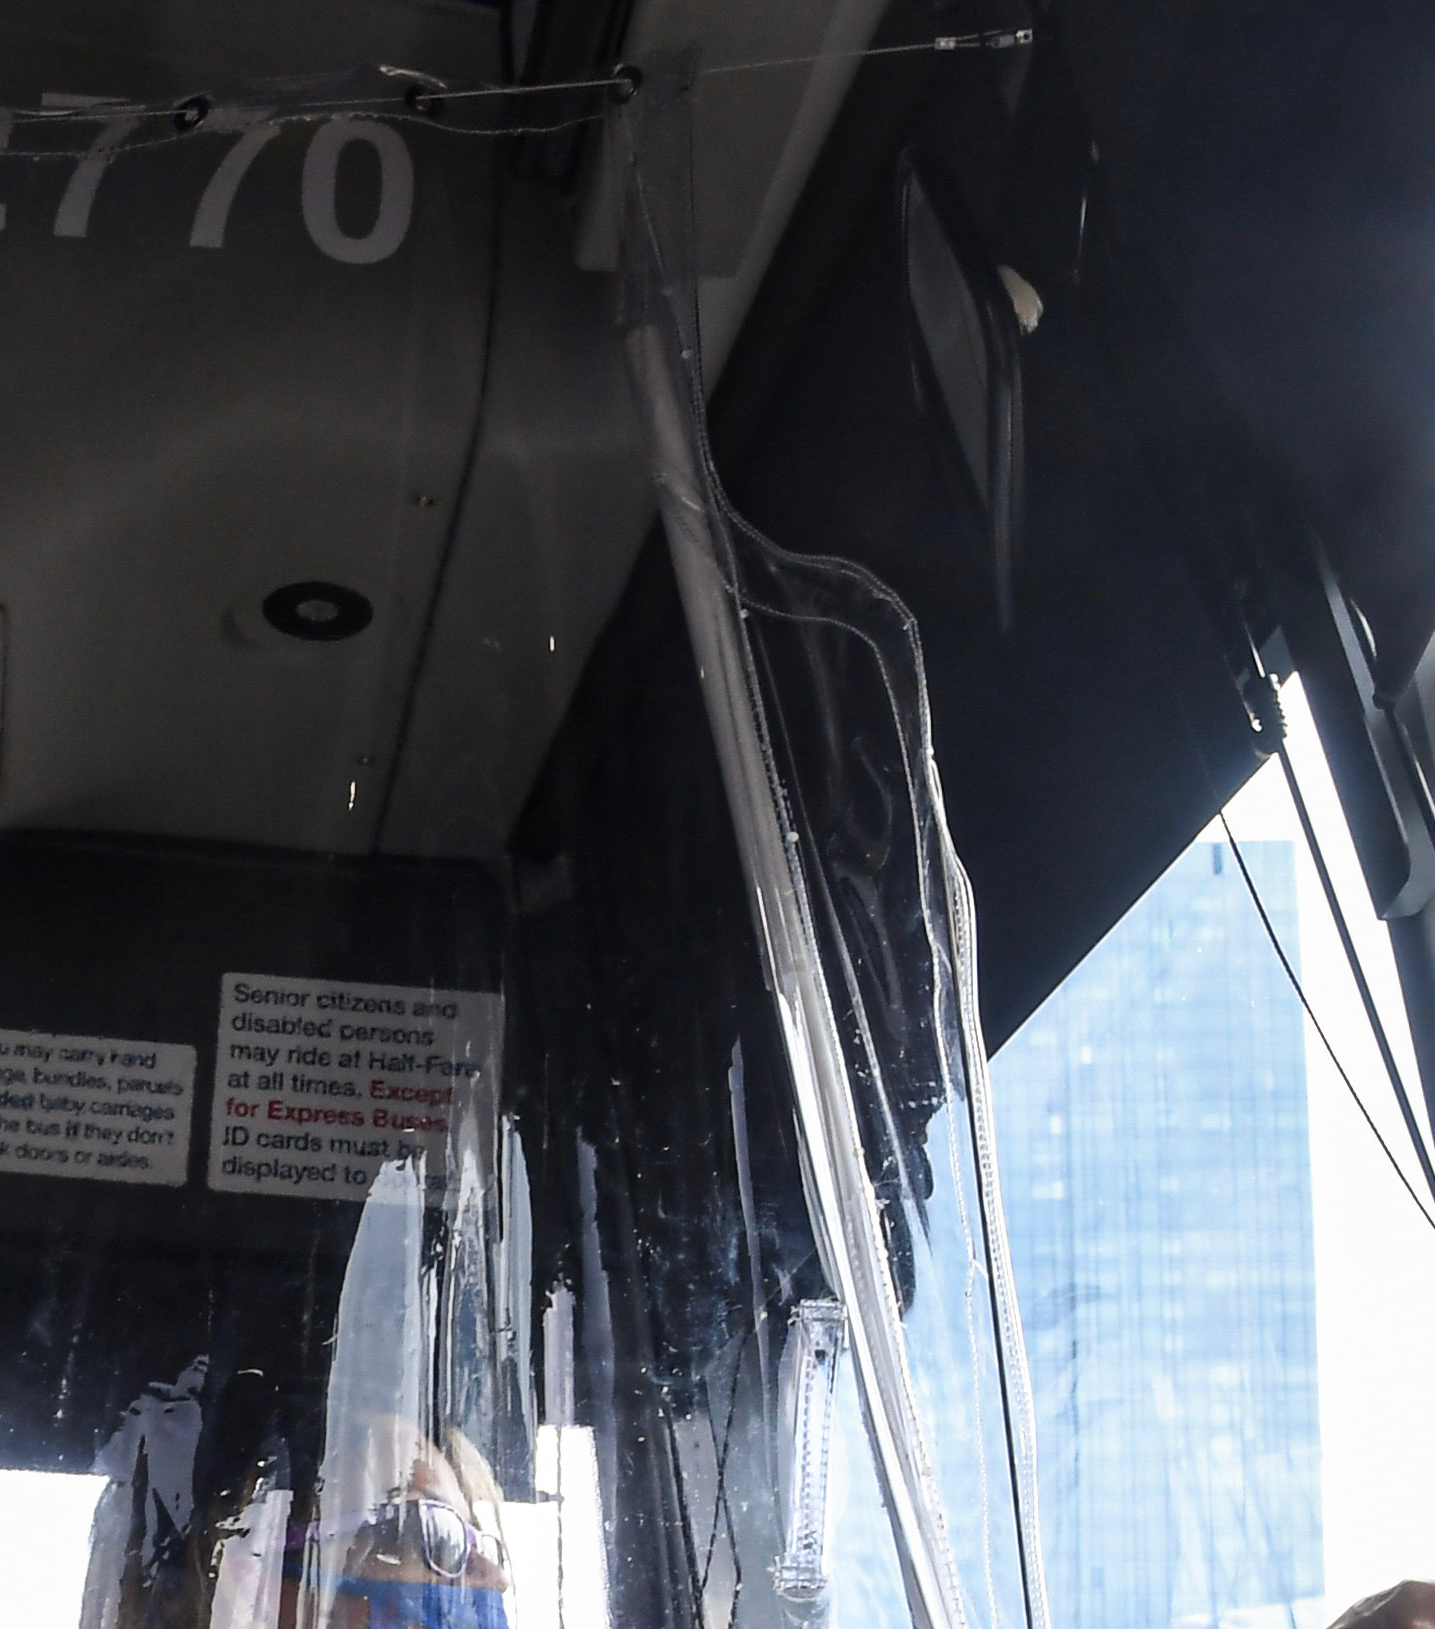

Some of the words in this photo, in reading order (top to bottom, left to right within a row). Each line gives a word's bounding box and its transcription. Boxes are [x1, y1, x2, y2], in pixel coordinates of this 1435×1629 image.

[234, 983, 309, 1008] Senior
[316, 992, 406, 1016] citizens
[414, 1001, 458, 1020] and
[232, 1014, 332, 1038] disabled
[340, 1024, 434, 1046] persons
[14, 1044, 53, 1062] may
[60, 1048, 105, 1065] carry
[230, 1044, 279, 1066] may
[288, 1046, 330, 1066] ride
[339, 1052, 360, 1069] at
[369, 1051, 480, 1079] Half-Fare
[228, 1072, 251, 1090] at
[258, 1073, 283, 1091] all
[370, 1080, 452, 1107] Except
[226, 1098, 258, 1117] for
[268, 1100, 364, 1126] Express
[27, 1119, 59, 1136] bus
[66, 1121, 82, 1137] if
[84, 1123, 122, 1144] they
[223, 1126, 249, 1146] ID
[257, 1132, 322, 1152] cards
[330, 1137, 390, 1156] must
[15, 1144, 69, 1163] doors
[74, 1150, 92, 1163] or
[222, 1157, 336, 1184] displayed
[345, 1167, 366, 1184] to
